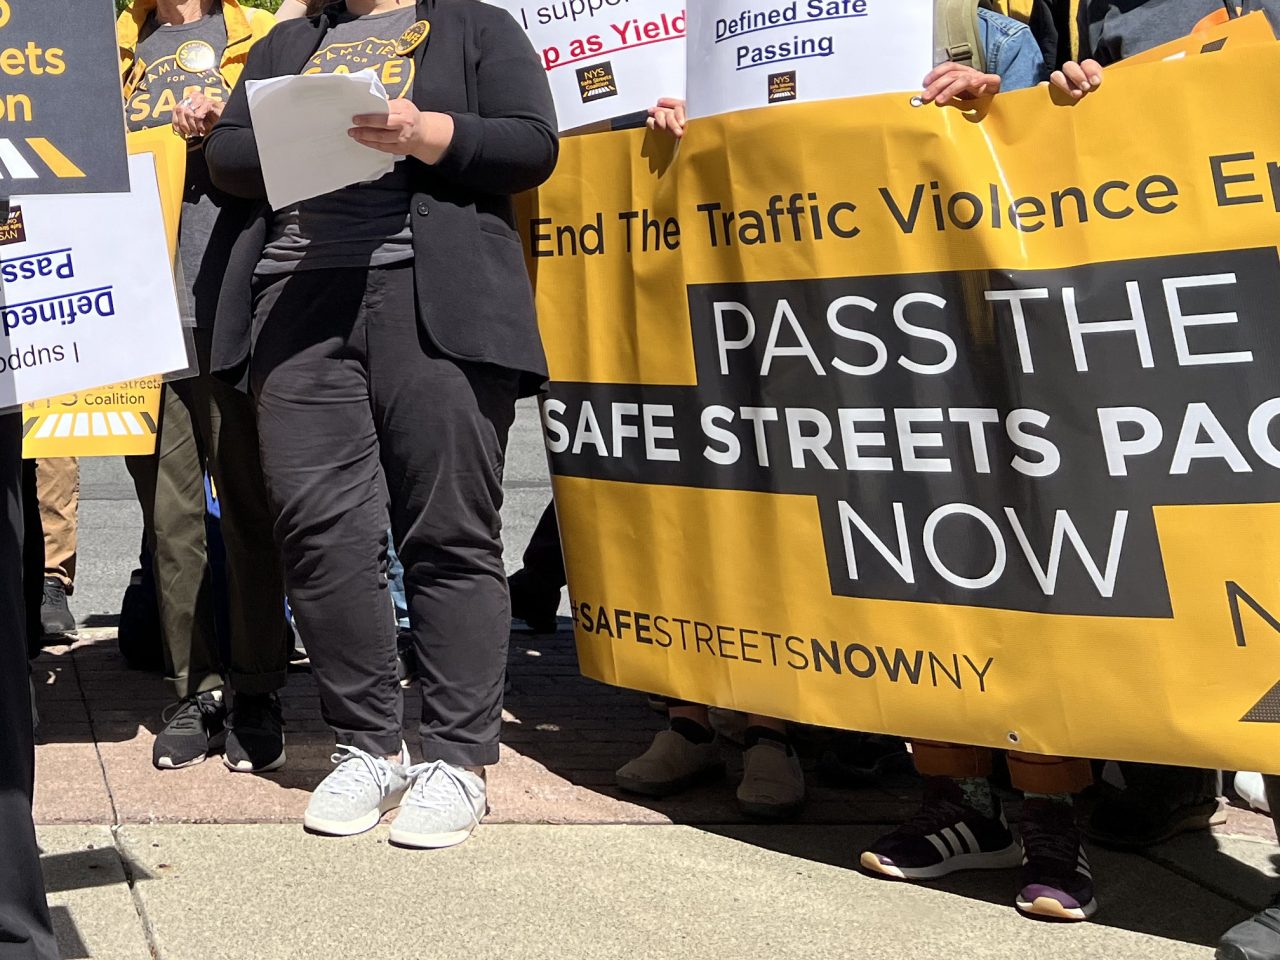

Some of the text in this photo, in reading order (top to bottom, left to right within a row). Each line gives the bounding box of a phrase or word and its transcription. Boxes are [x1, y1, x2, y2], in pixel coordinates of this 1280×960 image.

[521, 8, 528, 30] I
[716, 1, 797, 39] Defined
[346, 55, 368, 63] FOR
[570, 34, 602, 58] as
[737, 36, 833, 66] Passing
[167, 75, 185, 83] FOR
[584, 68, 605, 79] NYS
[530, 212, 604, 257] End
[618, 209, 681, 252] The
[697, 192, 861, 247] Traffic
[878, 174, 1179, 234] Violence
[1, 291, 115, 337] Defined
[712, 273, 1254, 376] PASS THE
[73, 342, 80, 363] I
[84, 393, 145, 405] Coalition
[543, 399, 681, 462] SAFE
[700, 405, 1061, 477] STREETS
[838, 500, 1128, 598] NOW
